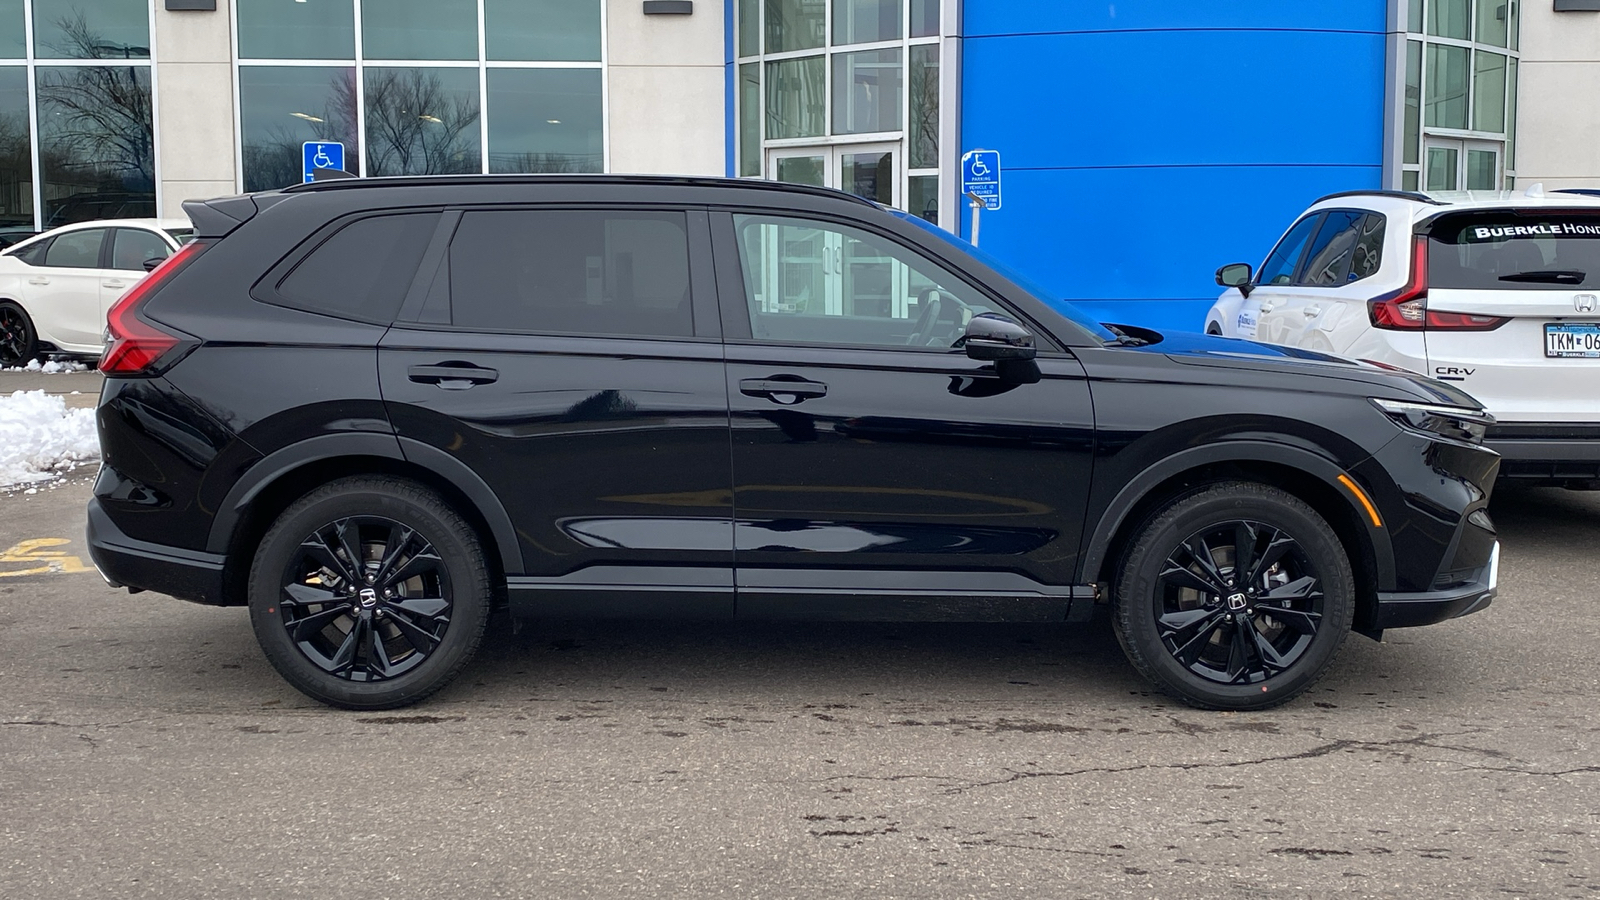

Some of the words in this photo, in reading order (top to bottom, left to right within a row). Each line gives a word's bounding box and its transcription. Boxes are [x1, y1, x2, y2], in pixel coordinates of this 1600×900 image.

[1475, 225, 1562, 238] BUERKLE
[1549, 334, 1574, 350] TKM
[1435, 366, 1476, 376] CR-V
